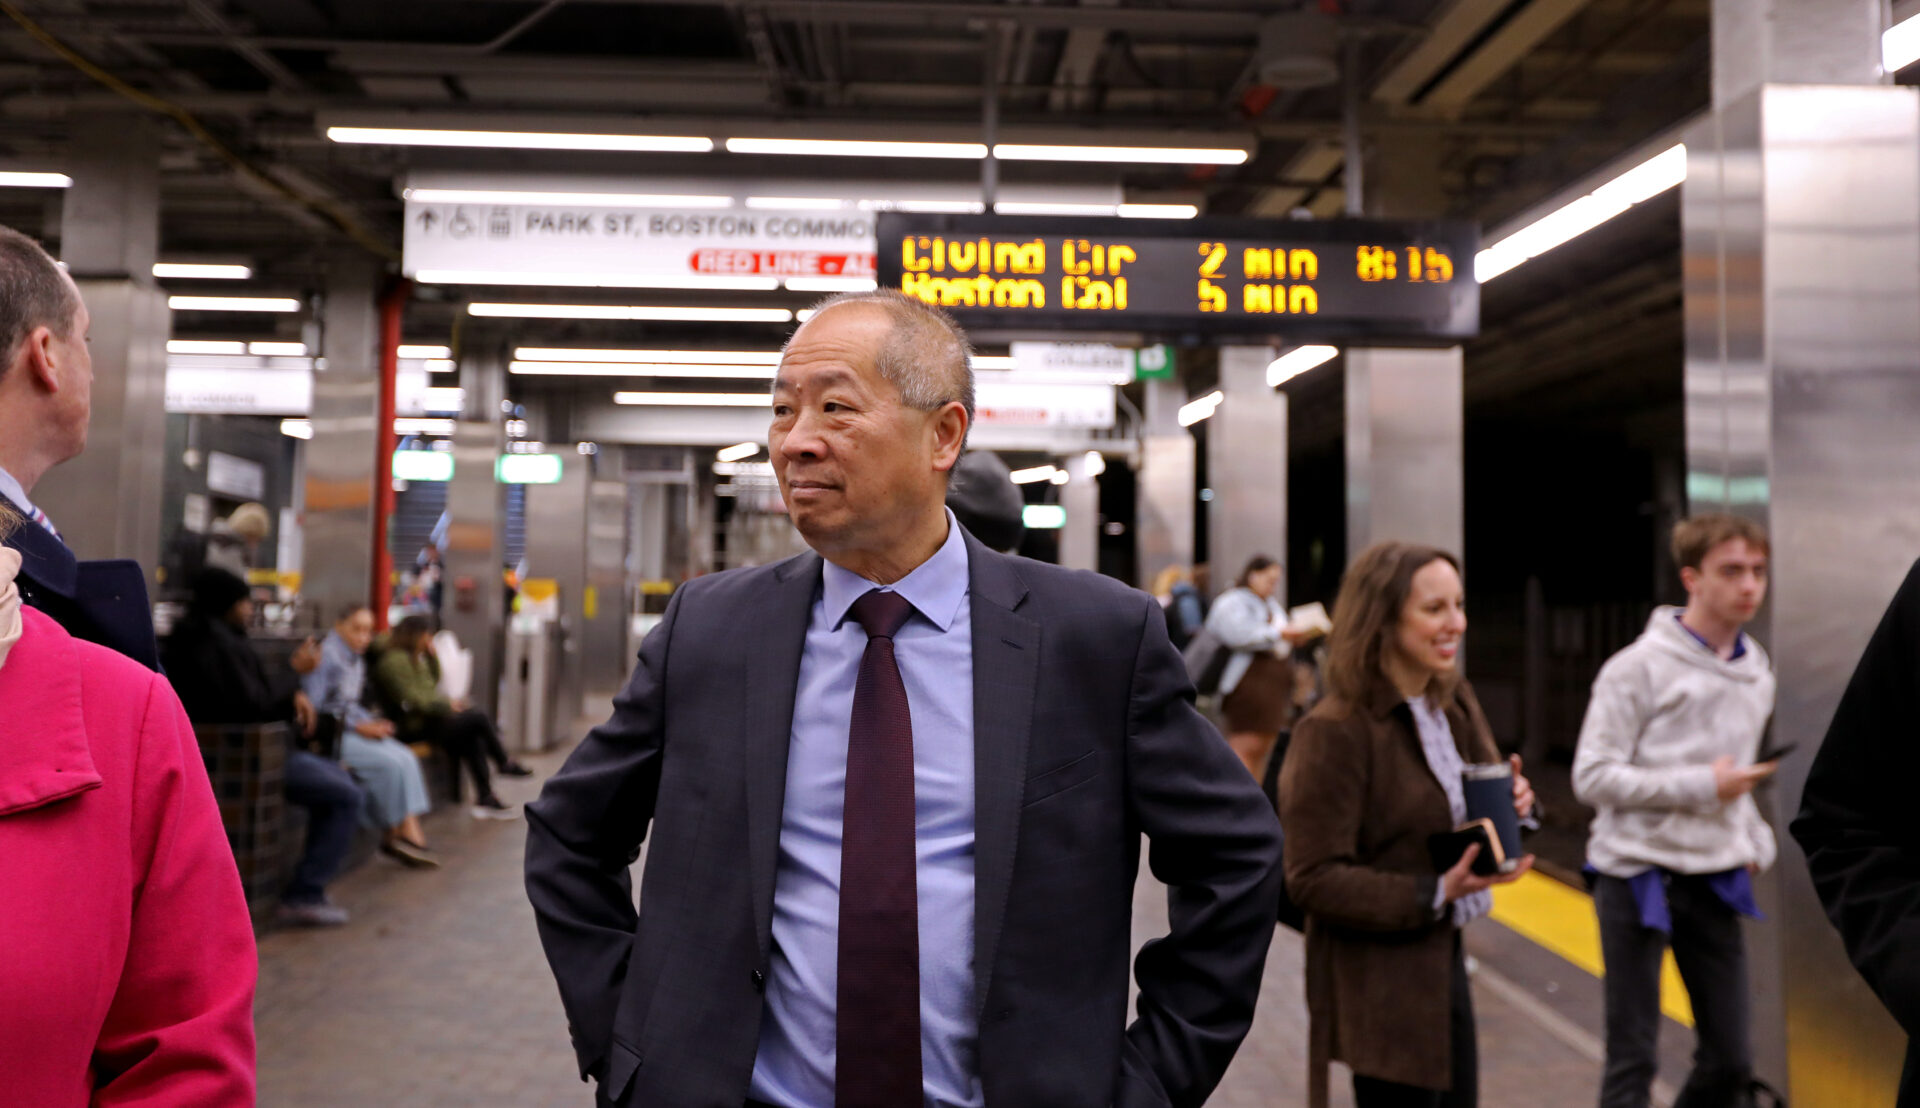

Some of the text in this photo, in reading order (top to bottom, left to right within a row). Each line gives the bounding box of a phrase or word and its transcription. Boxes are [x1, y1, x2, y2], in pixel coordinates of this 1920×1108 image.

[525, 211, 596, 234] PARK
[602, 213, 641, 238] ST,
[648, 215, 757, 238] BOSTON
[697, 251, 756, 275] RED
[759, 252, 820, 276] LINE
[1198, 243, 1228, 279] 2
[1243, 247, 1318, 280] min
[1198, 278, 1228, 312] 5
[1243, 284, 1318, 314] min
